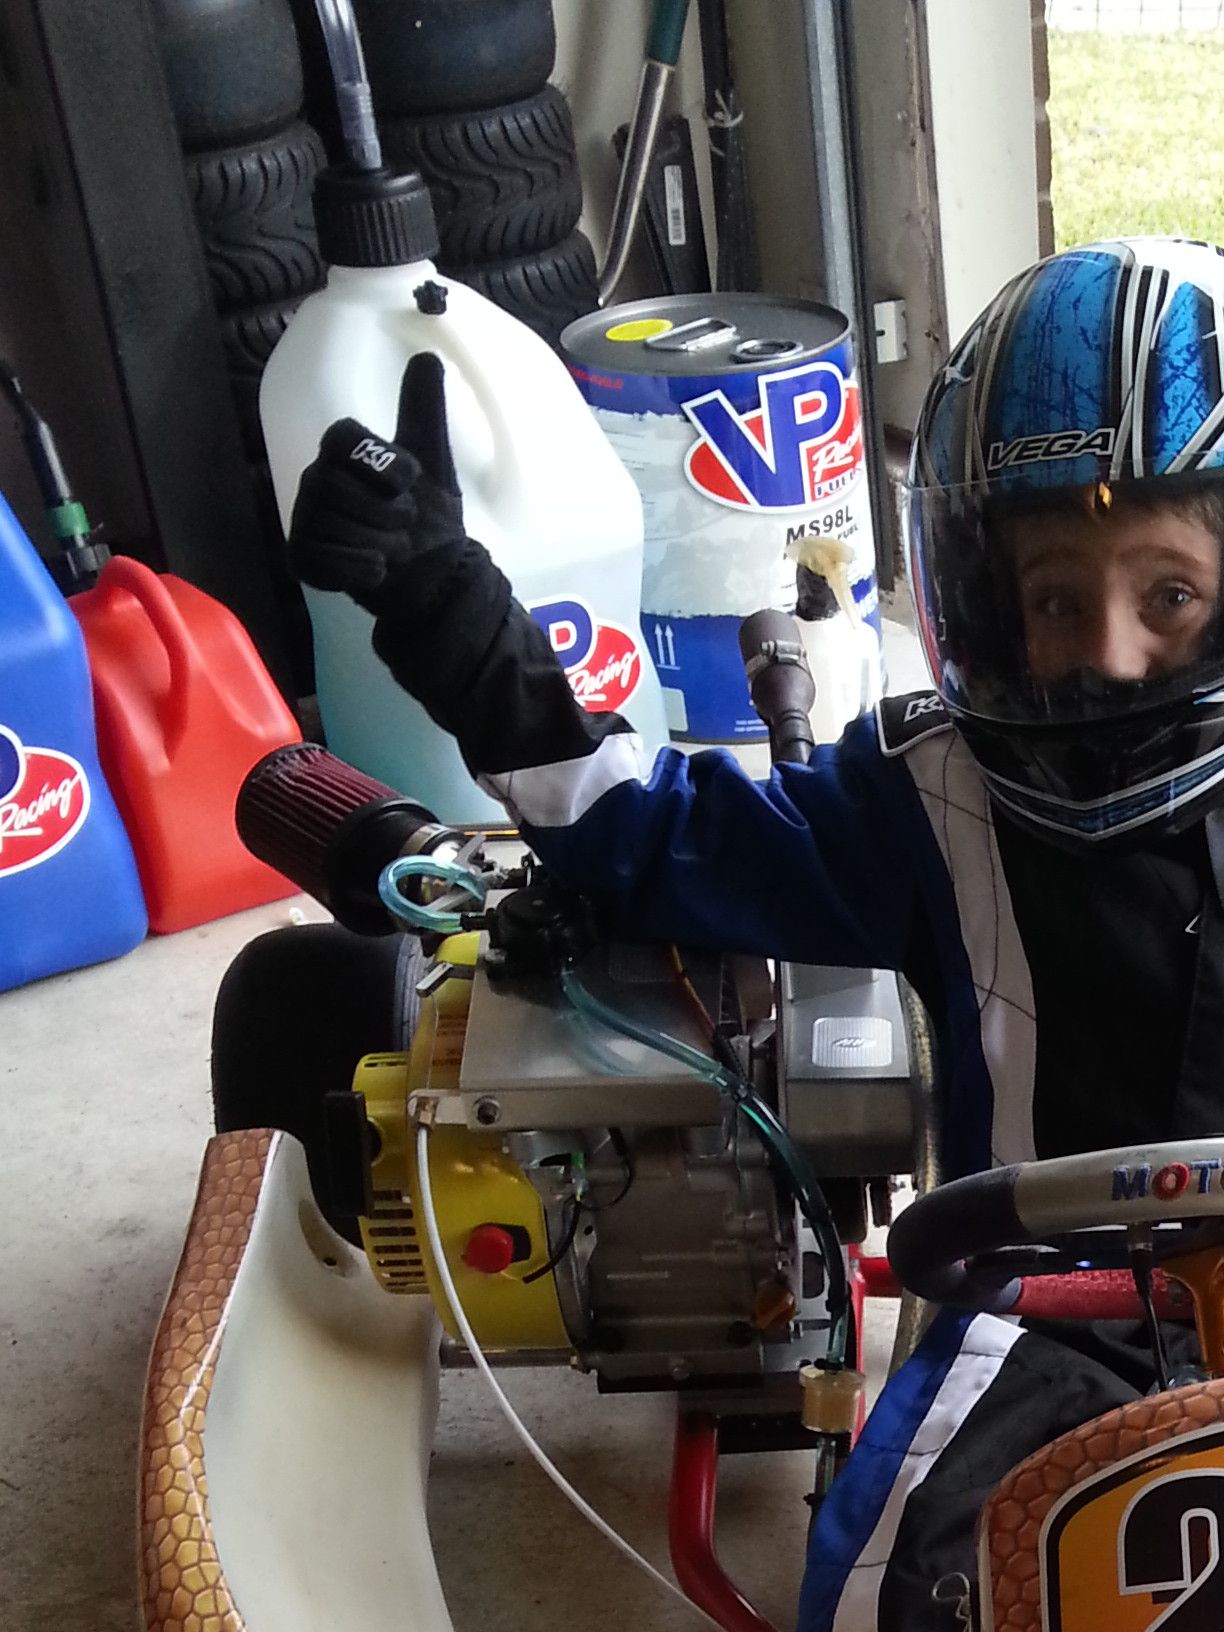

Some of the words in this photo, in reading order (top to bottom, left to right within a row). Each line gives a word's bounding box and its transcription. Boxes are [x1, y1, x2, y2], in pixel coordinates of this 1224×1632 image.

[683, 363, 844, 508] VP
[987, 427, 1116, 471] VEGA
[785, 504, 854, 546] MS98L
